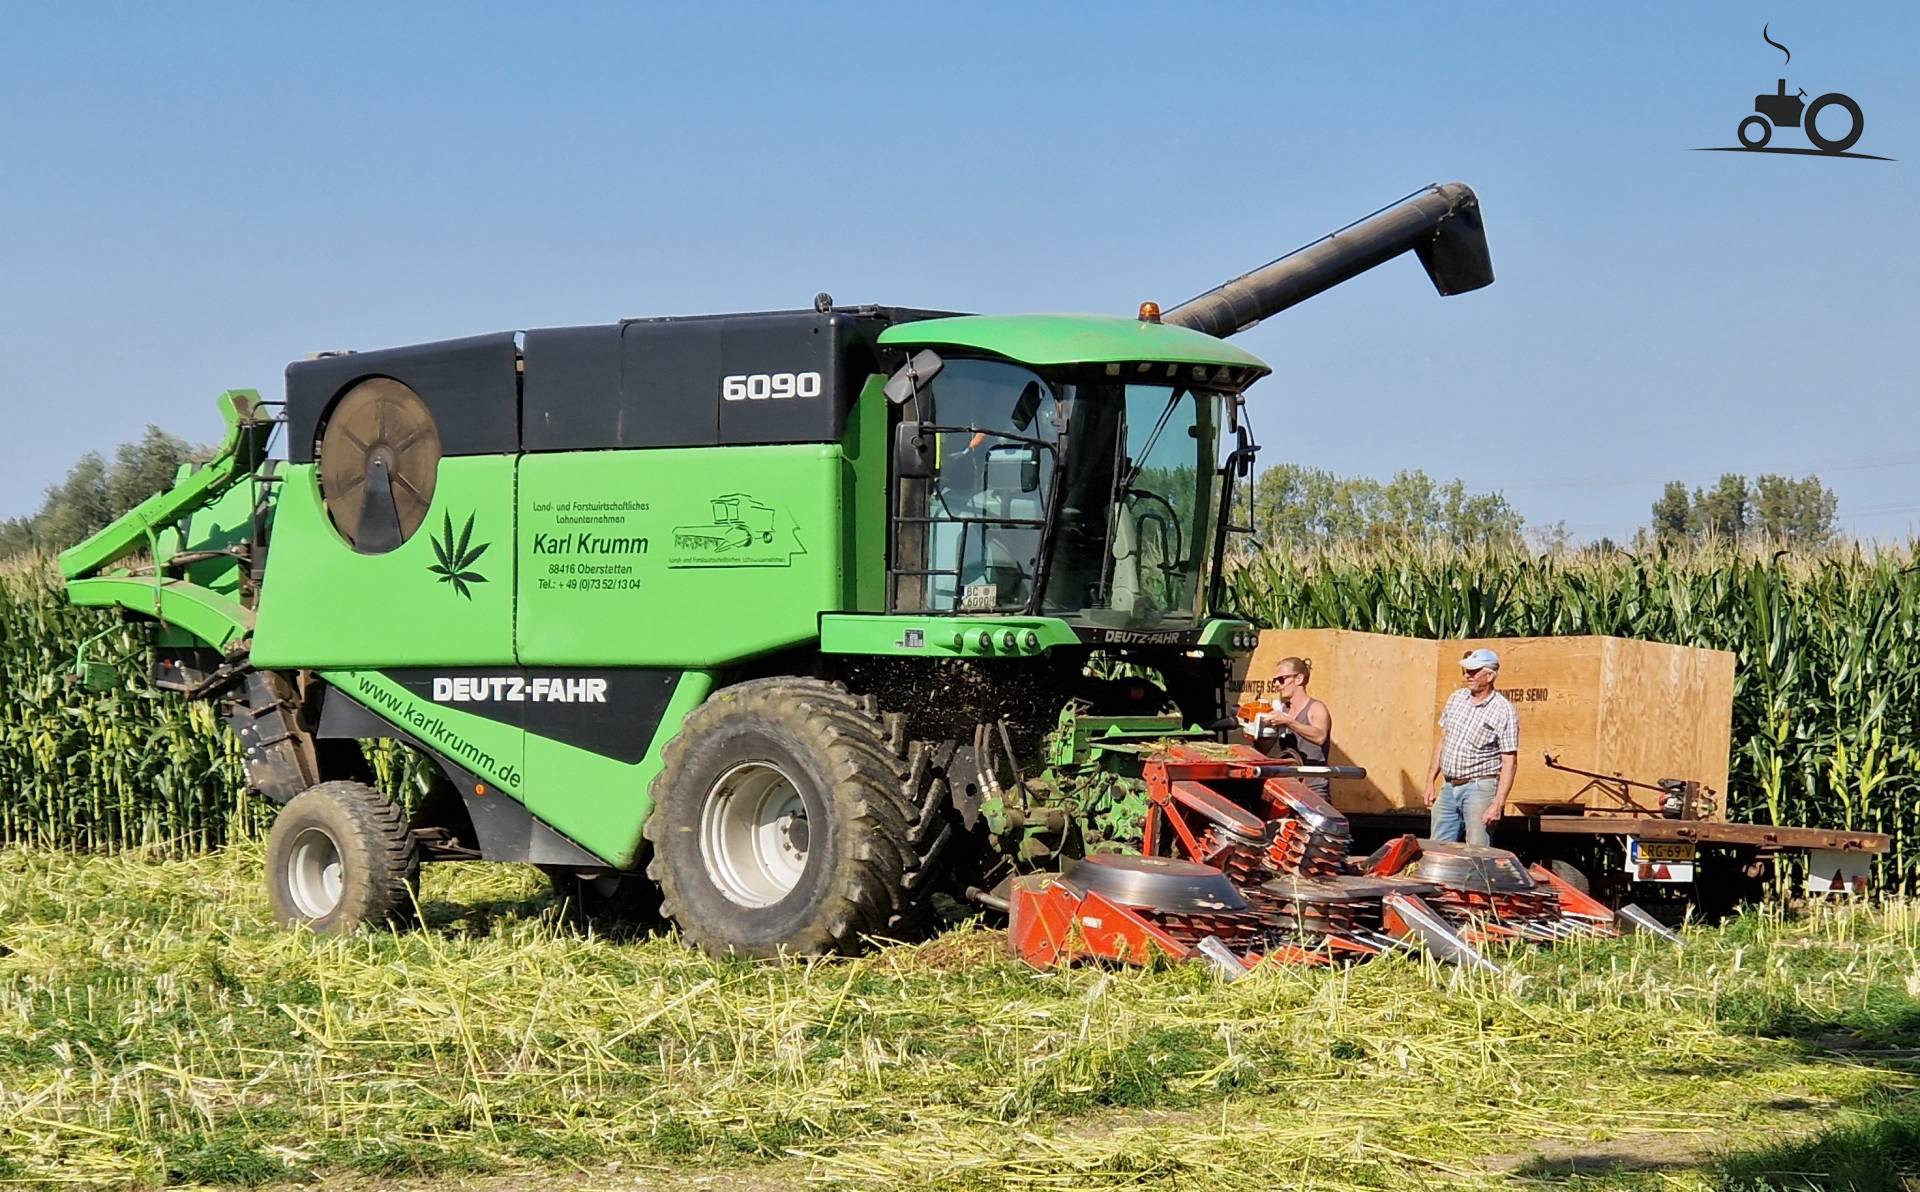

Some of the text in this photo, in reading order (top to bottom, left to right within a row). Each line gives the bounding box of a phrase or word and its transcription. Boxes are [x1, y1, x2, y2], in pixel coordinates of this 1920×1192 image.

[723, 372, 821, 401] 6090
[532, 501, 650, 511] Land- und Forstwirtschaftliches
[556, 515, 625, 524] Lohnunternehmen
[533, 533, 649, 554] Karl Krumm
[548, 564, 633, 574] 88416 Oberstetten
[1104, 630, 1180, 644] DEUTZ-FAHR
[432, 677, 607, 702] DEUTZ-FAHR
[1526, 688, 1549, 702] SEMO
[359, 677, 521, 788] www.karlkrumm.de
